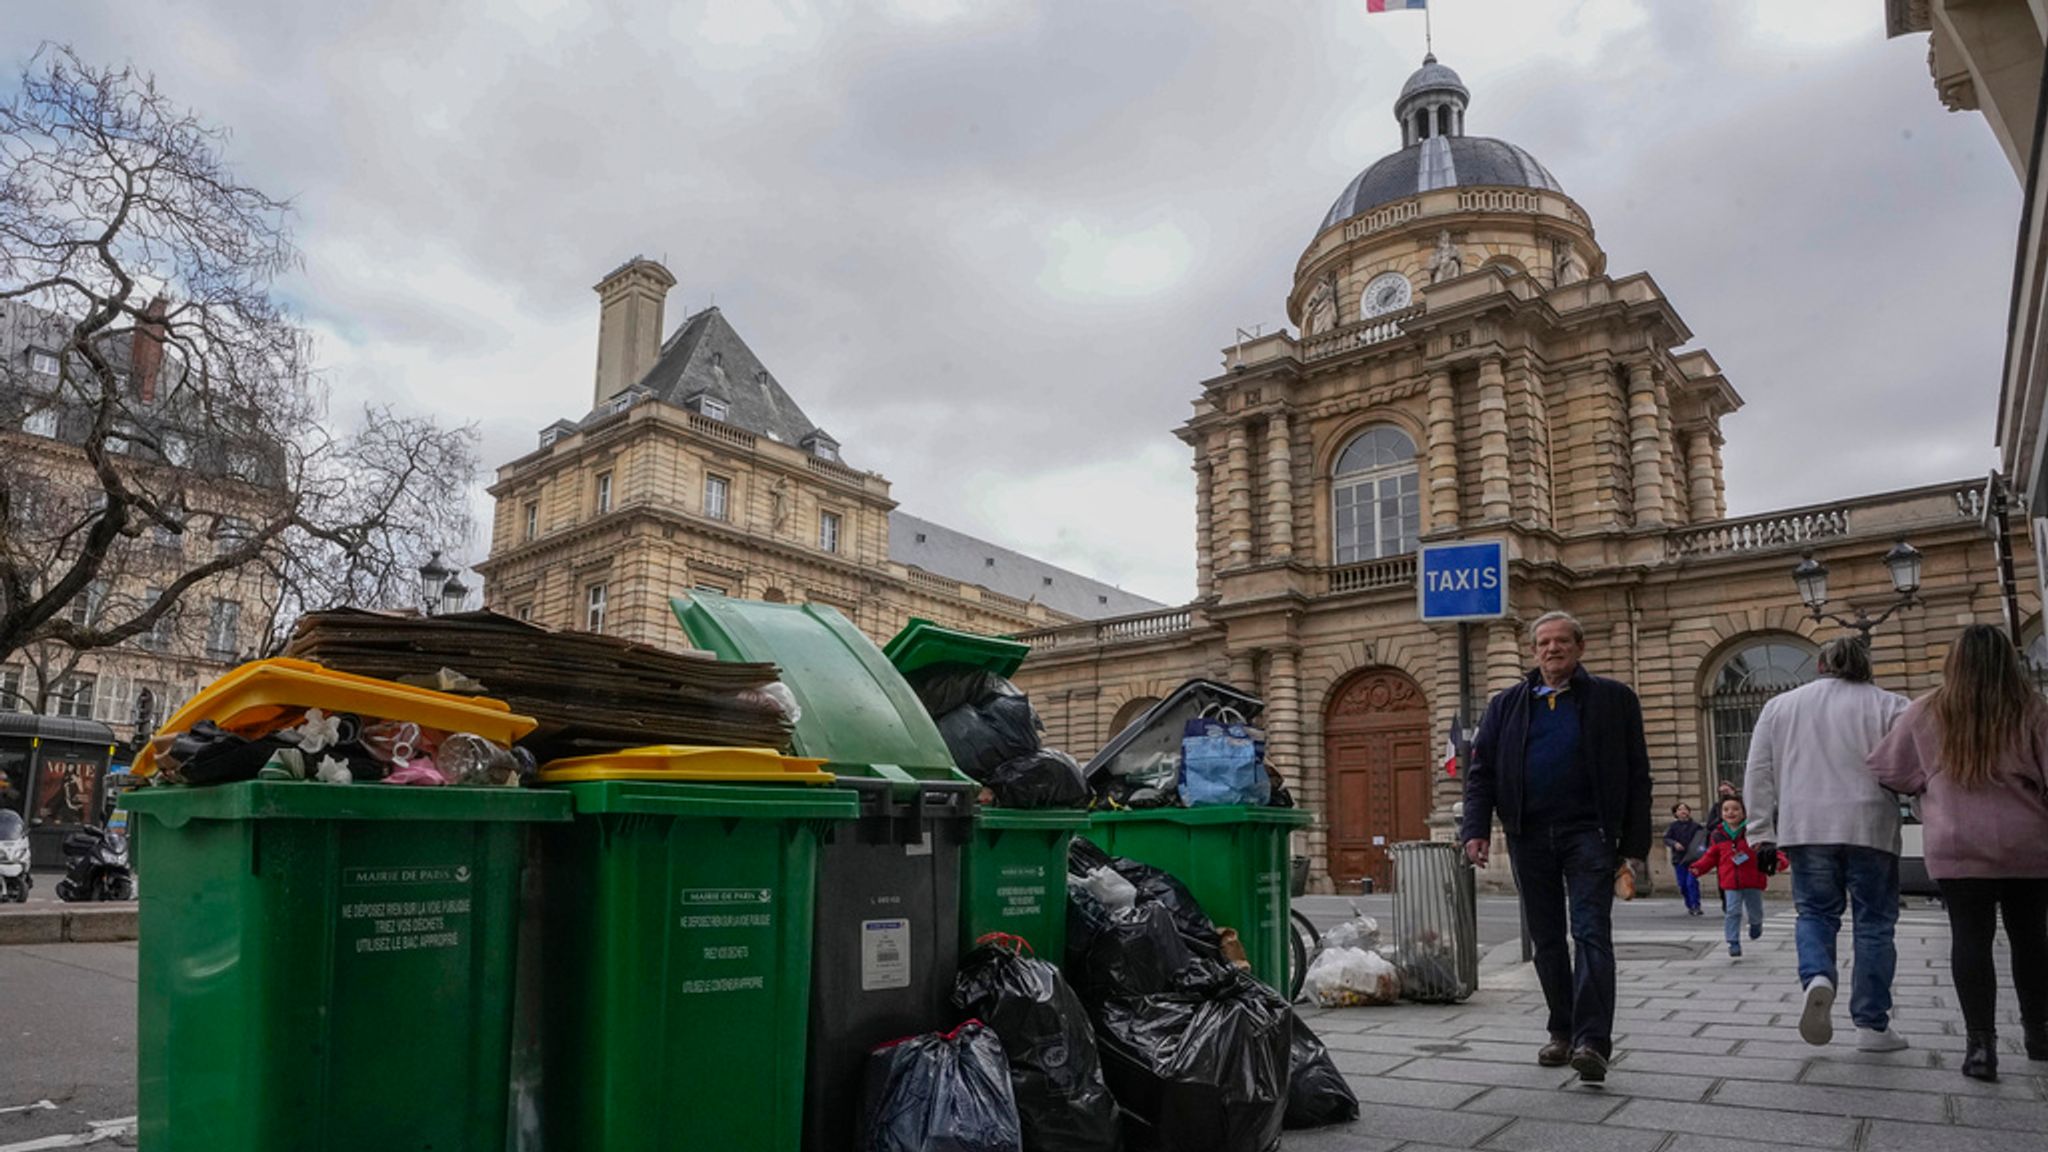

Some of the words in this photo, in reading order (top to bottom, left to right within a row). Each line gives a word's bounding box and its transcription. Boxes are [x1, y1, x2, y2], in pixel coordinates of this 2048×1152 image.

[1426, 566, 1498, 592] TAXIS
[47, 760, 96, 778] VOUE
[356, 871, 398, 881] MAIRIE
[402, 870, 417, 880] DE
[420, 869, 449, 879] PARIS
